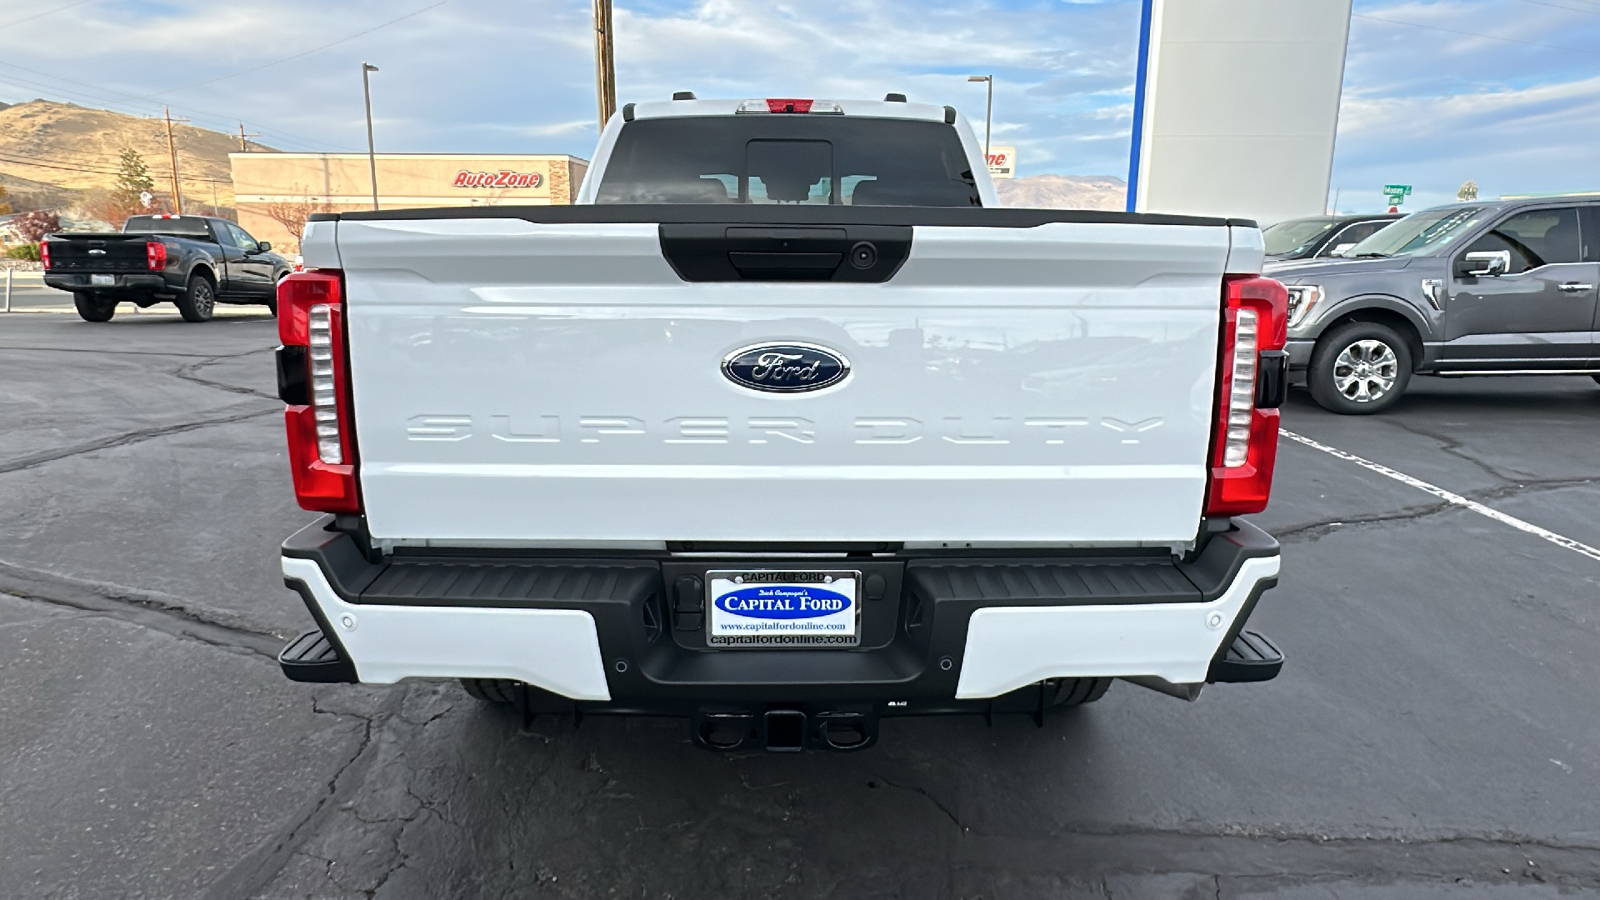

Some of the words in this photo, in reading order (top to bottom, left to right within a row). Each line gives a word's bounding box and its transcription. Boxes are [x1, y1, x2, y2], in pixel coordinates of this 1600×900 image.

[453, 170, 541, 188] AutoZone
[751, 352, 820, 381] Ford
[406, 414, 815, 444] SUPER
[854, 416, 1164, 445] DUTY
[742, 572, 789, 582] CAPITAL
[793, 572, 825, 582] FORD
[724, 596, 794, 611] CAPITAL
[799, 596, 843, 611] FORD
[720, 622, 846, 632] www.capitalfordonline.com
[710, 635, 857, 646] capitalfordonline.com
